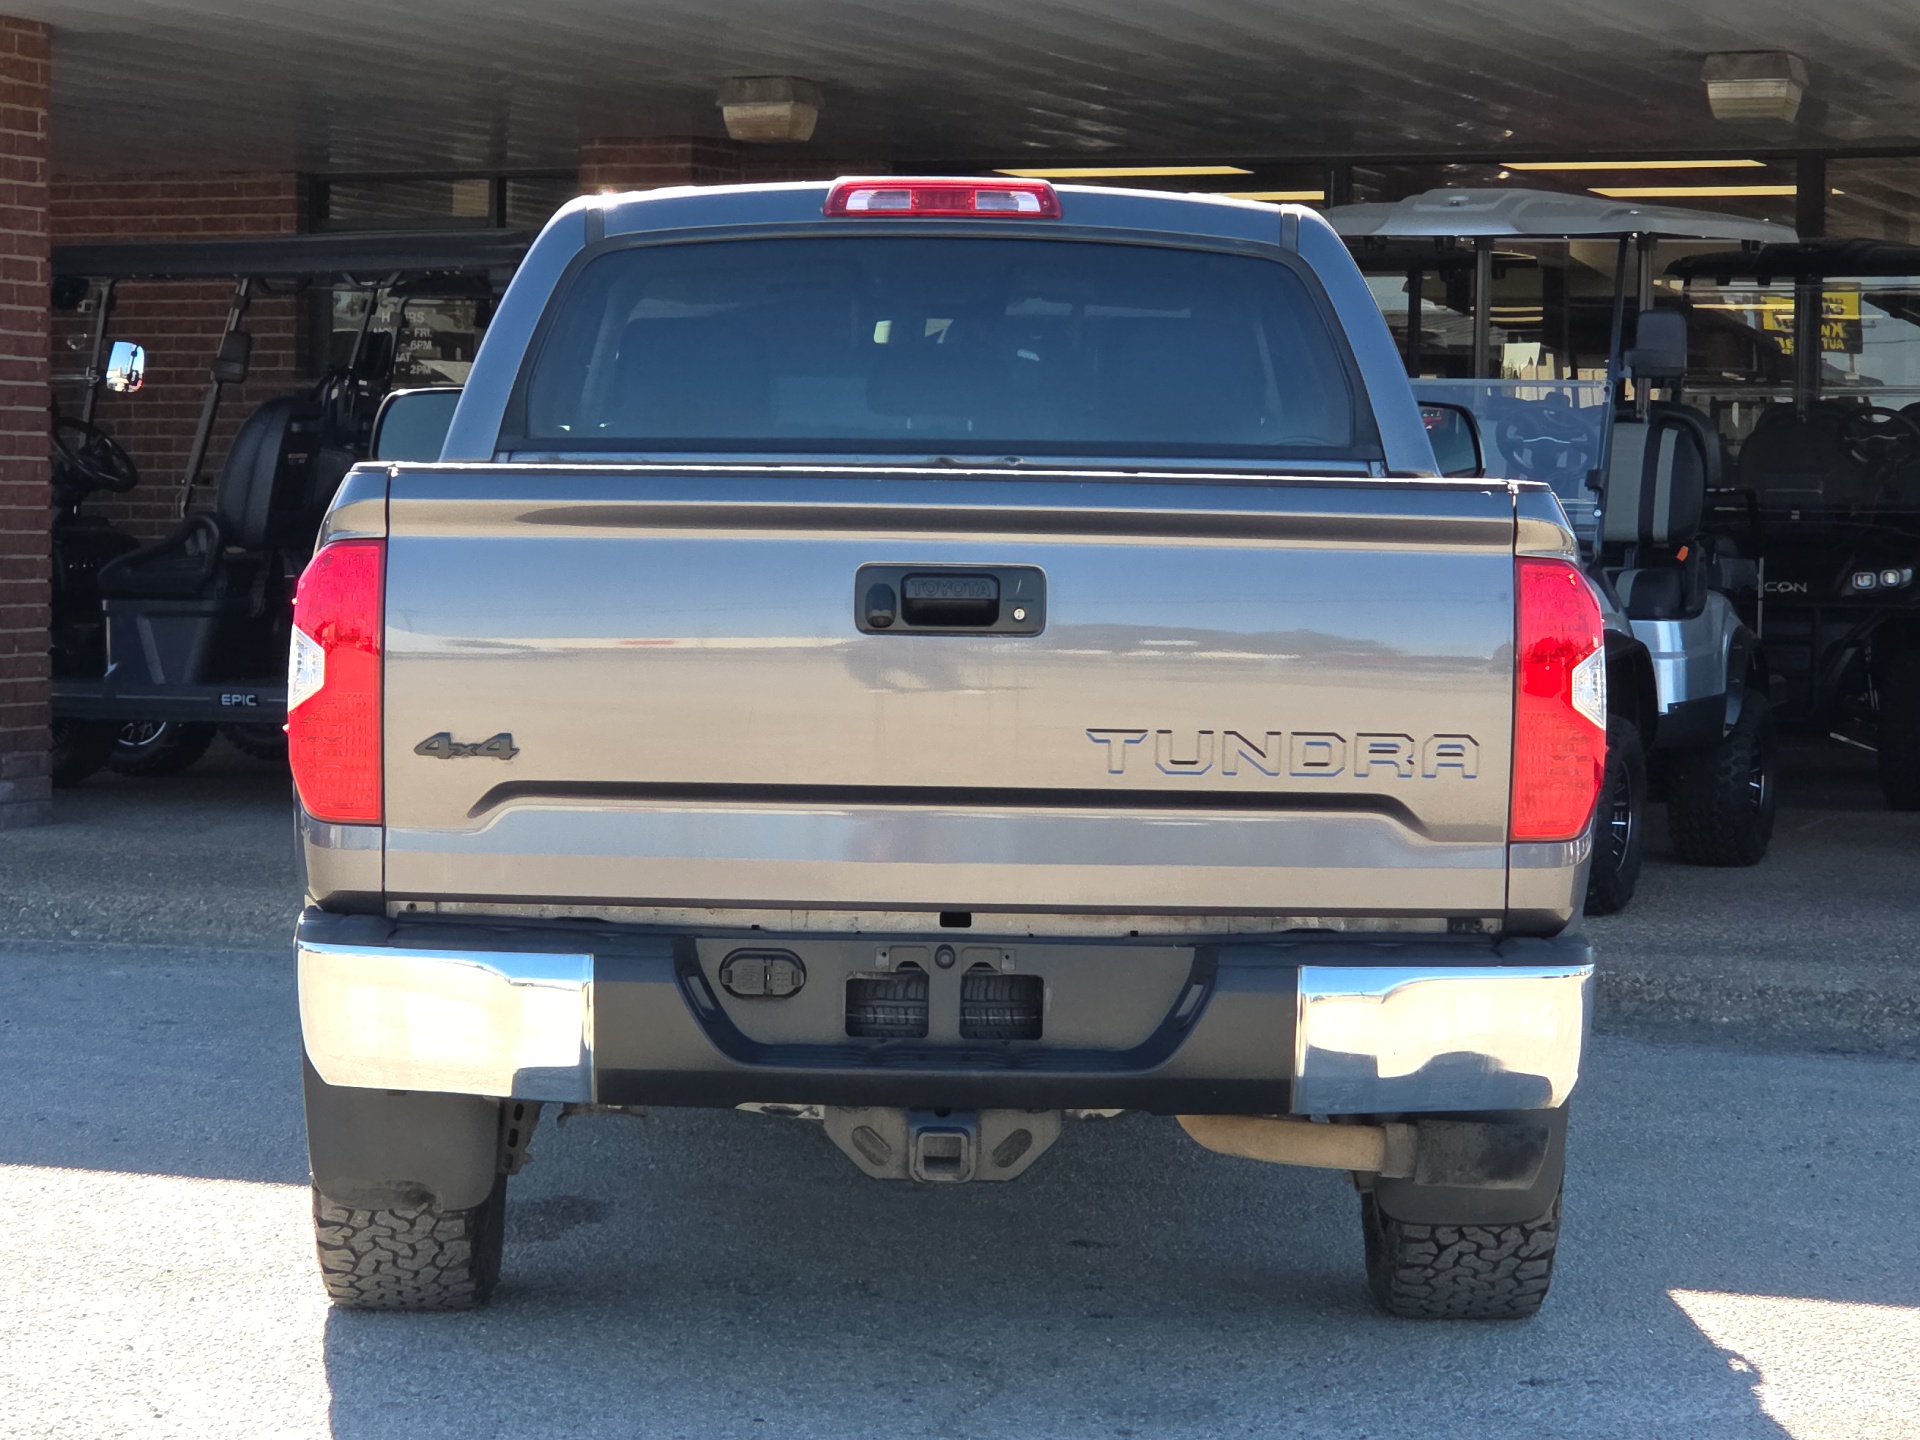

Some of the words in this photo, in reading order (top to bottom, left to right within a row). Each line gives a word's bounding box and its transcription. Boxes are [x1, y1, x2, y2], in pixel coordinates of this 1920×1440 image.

[381, 310, 425, 324] HRS
[410, 340, 432, 350] 6PM
[409, 364, 432, 375] 2PM
[910, 579, 992, 598] TOYOTA
[1757, 581, 1808, 593] CON
[221, 693, 257, 706] EPIC
[1085, 728, 1481, 779] TUNDRA
